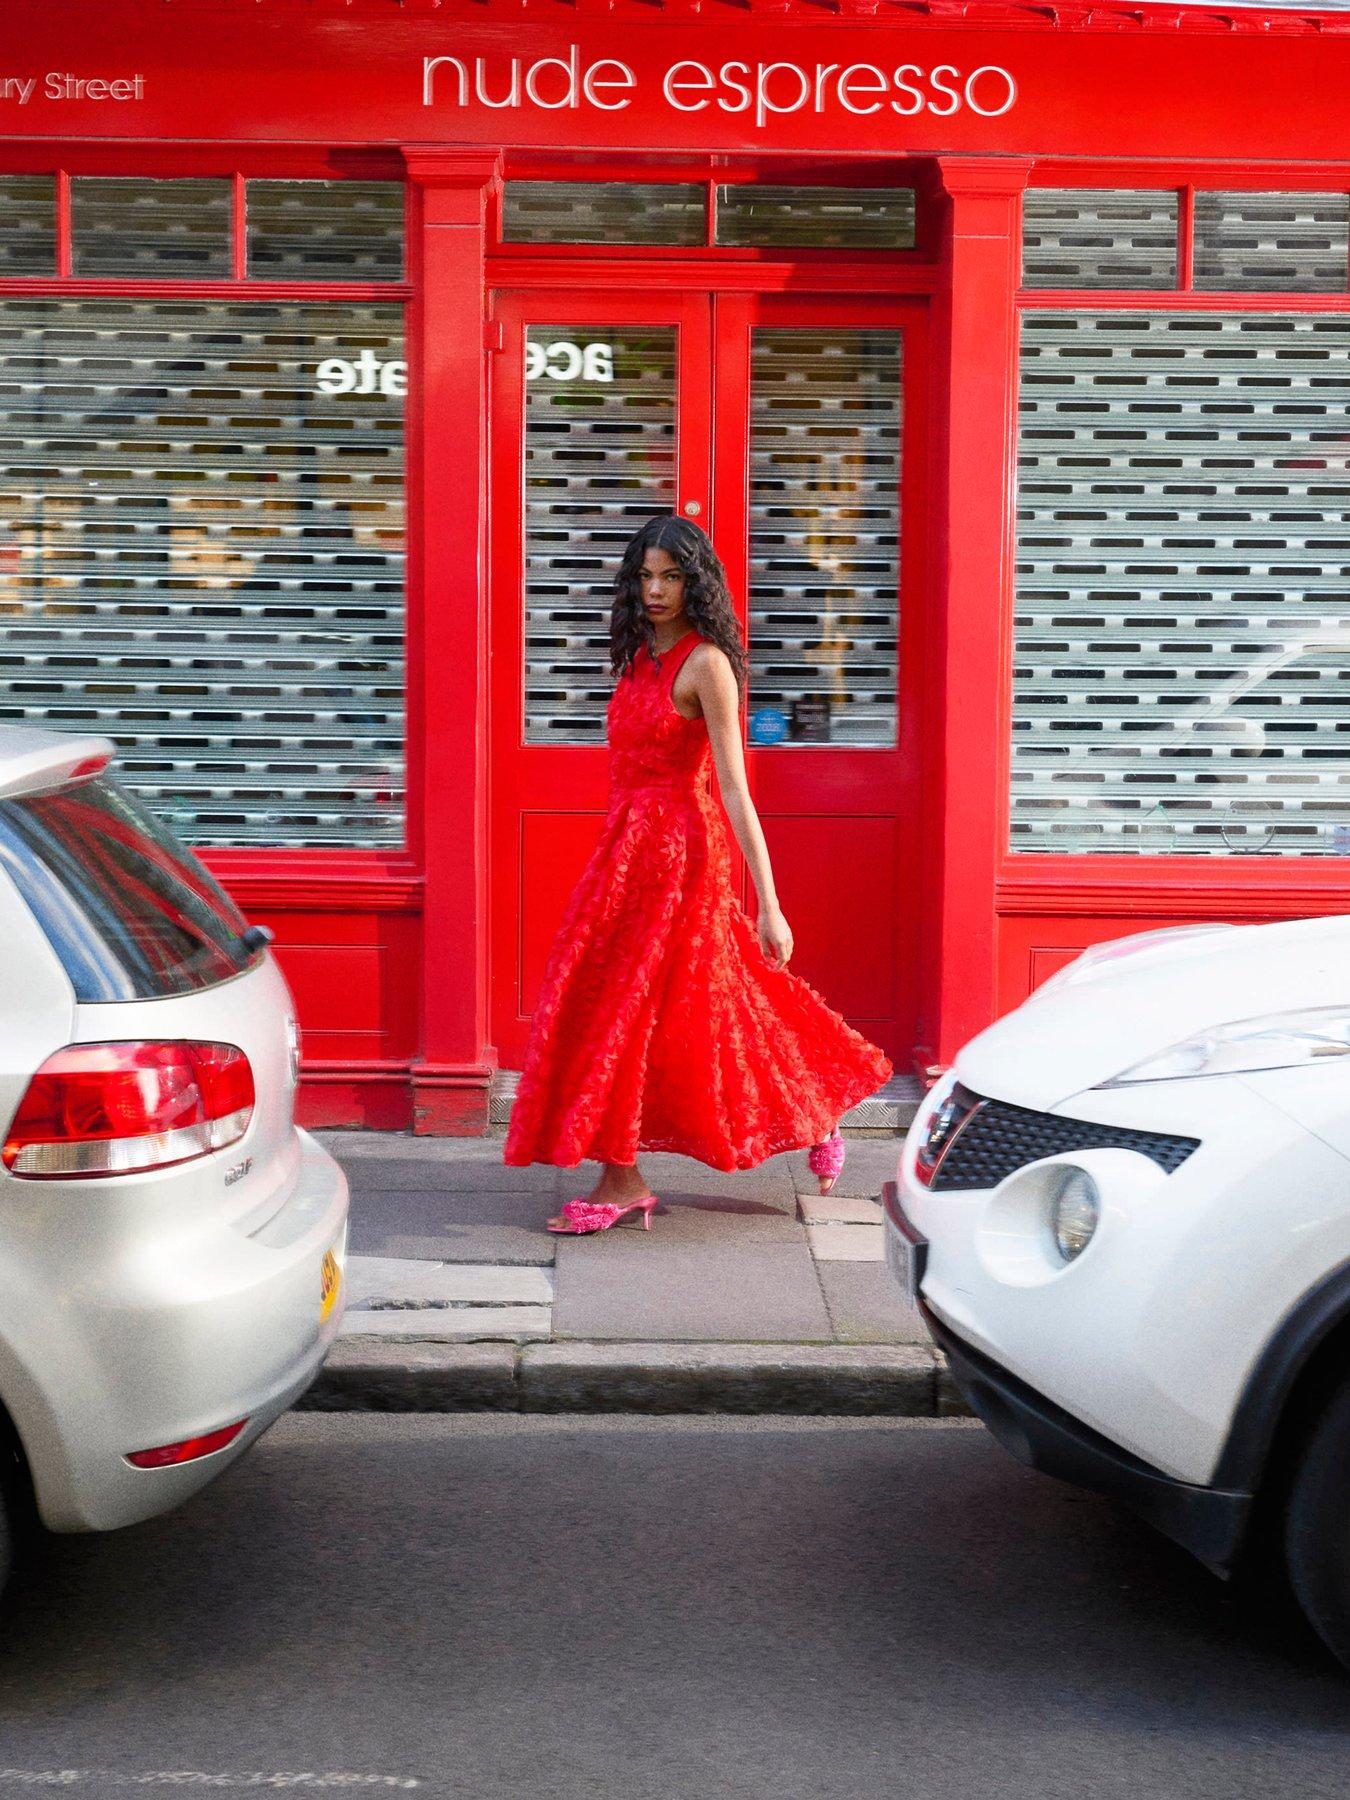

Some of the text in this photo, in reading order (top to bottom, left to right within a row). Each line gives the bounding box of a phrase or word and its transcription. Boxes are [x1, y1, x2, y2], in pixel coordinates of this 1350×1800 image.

[0, 72, 146, 105] ry Street
[422, 44, 1018, 127] nude espresso
